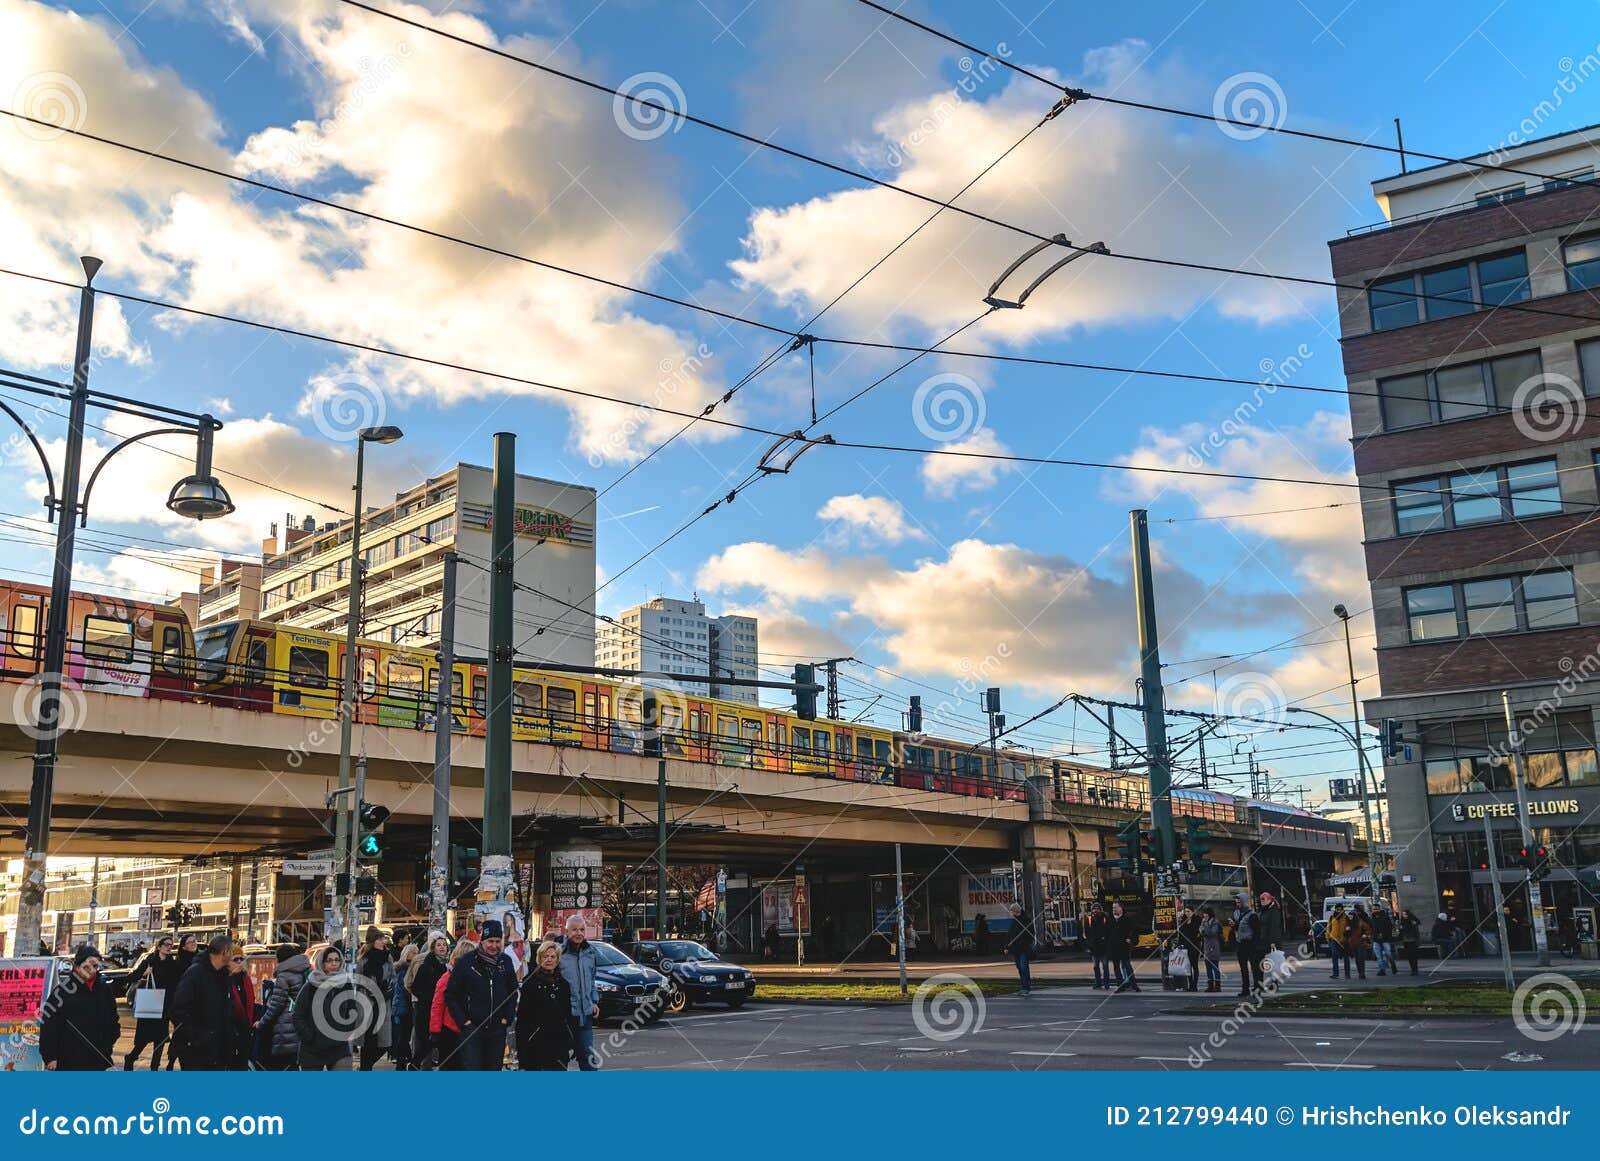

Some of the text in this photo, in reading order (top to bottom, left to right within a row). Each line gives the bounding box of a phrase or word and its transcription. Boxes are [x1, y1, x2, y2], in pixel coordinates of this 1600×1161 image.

[290, 633, 331, 646] TechniSat
[1467, 799, 1580, 819] COFFEE ELLOWS
[0, 969, 44, 980] ERLIN
